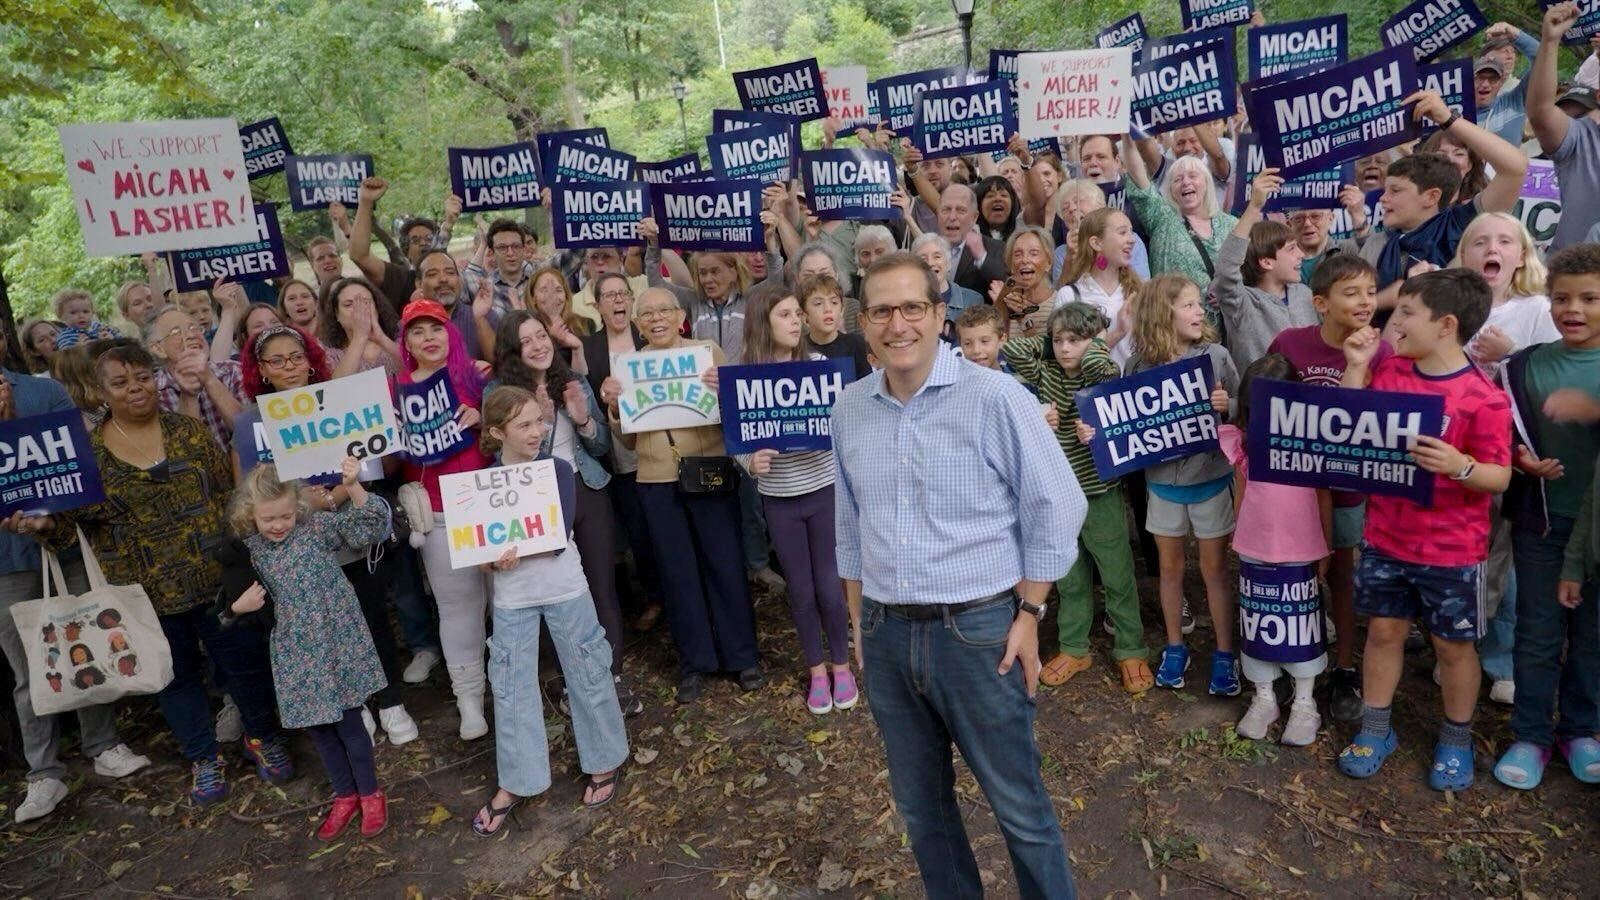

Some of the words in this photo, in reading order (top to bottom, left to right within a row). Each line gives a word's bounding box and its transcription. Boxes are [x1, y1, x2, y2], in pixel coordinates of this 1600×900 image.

[1192, 6, 1250, 32] LASHER
[1098, 19, 1140, 49] MICAH
[1260, 24, 1337, 58] MICAH
[1413, 14, 1477, 59] ASHER
[1041, 60, 1056, 73] WE
[1062, 55, 1115, 74] SUPPORT
[1261, 57, 1280, 65] FOR
[1283, 49, 1337, 62] CONGRESS
[744, 66, 814, 99] MICAH
[1043, 73, 1098, 95] MICAH
[1130, 51, 1218, 102] MICAH
[768, 90, 815, 104] CONGRESS
[923, 88, 1003, 124] MICAH
[1132, 100, 1153, 110] FOR
[1157, 80, 1219, 103] CONGRESS
[1274, 60, 1402, 134] MICAH
[829, 105, 864, 118] CAH
[891, 114, 914, 130] READ
[1134, 89, 1224, 131] LASHER
[1281, 129, 1313, 145] FOR
[1317, 100, 1403, 134] CONGRESS
[924, 122, 947, 132] FOR
[948, 115, 1003, 128] CONGRESS
[92, 138, 124, 160] WE
[138, 134, 222, 157] SUPPORT
[240, 125, 280, 152] CAH
[720, 132, 789, 169] MICAH
[925, 124, 1005, 154] LASHER
[1282, 135, 1331, 168] READY
[1332, 133, 1347, 146] FOR
[1347, 130, 1361, 142] THE
[1362, 110, 1406, 141] FIGHT
[245, 150, 286, 173] SHER
[296, 161, 367, 181] MICAH
[461, 150, 536, 180] MICAH
[558, 145, 629, 180] MICAH
[558, 168, 576, 176] FOR
[727, 168, 747, 177] FOR
[812, 160, 891, 185] MICAH
[464, 179, 484, 188] FOR
[488, 174, 537, 185] CONGRESS
[1305, 181, 1340, 198] FIGHT
[301, 186, 361, 205] LASHE
[465, 183, 541, 207] LASHER
[564, 189, 643, 214] MICAH
[664, 190, 752, 218] MICAH
[815, 195, 843, 211] READY
[863, 193, 892, 209] FIGHT
[566, 222, 644, 242] LASHER
[668, 227, 701, 242] READY
[722, 227, 752, 242] FIGHT
[692, 218, 752, 226] CONGRESS
[181, 251, 202, 259] FOR
[205, 241, 272, 257] CONGRESS
[182, 250, 277, 283] LASHER
[628, 354, 697, 380] TEAM
[1307, 365, 1344, 378] Kangar
[400, 379, 451, 424] ICAH
[621, 380, 718, 418] LASHER
[736, 372, 842, 410] MICAH
[1094, 367, 1210, 428] MICAH
[267, 389, 324, 421] GO!
[740, 411, 766, 420] FOR
[771, 407, 832, 418] CONGRES
[279, 404, 384, 449] MICAH
[740, 420, 781, 441] READY
[783, 423, 795, 432] FOR
[795, 422, 807, 431] THE
[808, 418, 832, 436] FIG
[1104, 424, 1131, 439] FOR
[1136, 403, 1212, 428] CONGRESS
[1270, 396, 1422, 449] MICAH
[0, 425, 77, 474] CAH
[347, 427, 394, 461] GO!
[401, 420, 463, 457] ASHER
[1107, 414, 1218, 467] LASHER
[1270, 437, 1305, 450] FOR
[1311, 441, 1415, 462] CONGRESS
[0, 461, 79, 485] ONGRESS
[474, 466, 533, 491] LET'S
[1270, 449, 1325, 473] READY
[1326, 460, 1343, 471] FOR
[1343, 461, 1360, 473] THE
[1363, 461, 1417, 486] FIGHT
[2, 490, 18, 502] FOR
[18, 487, 33, 498] THE
[35, 472, 84, 498] FIGHT
[489, 490, 520, 508] GO
[1253, 585, 1265, 595] THE
[1266, 587, 1280, 597] FOR
[1240, 608, 1321, 646] MICA
